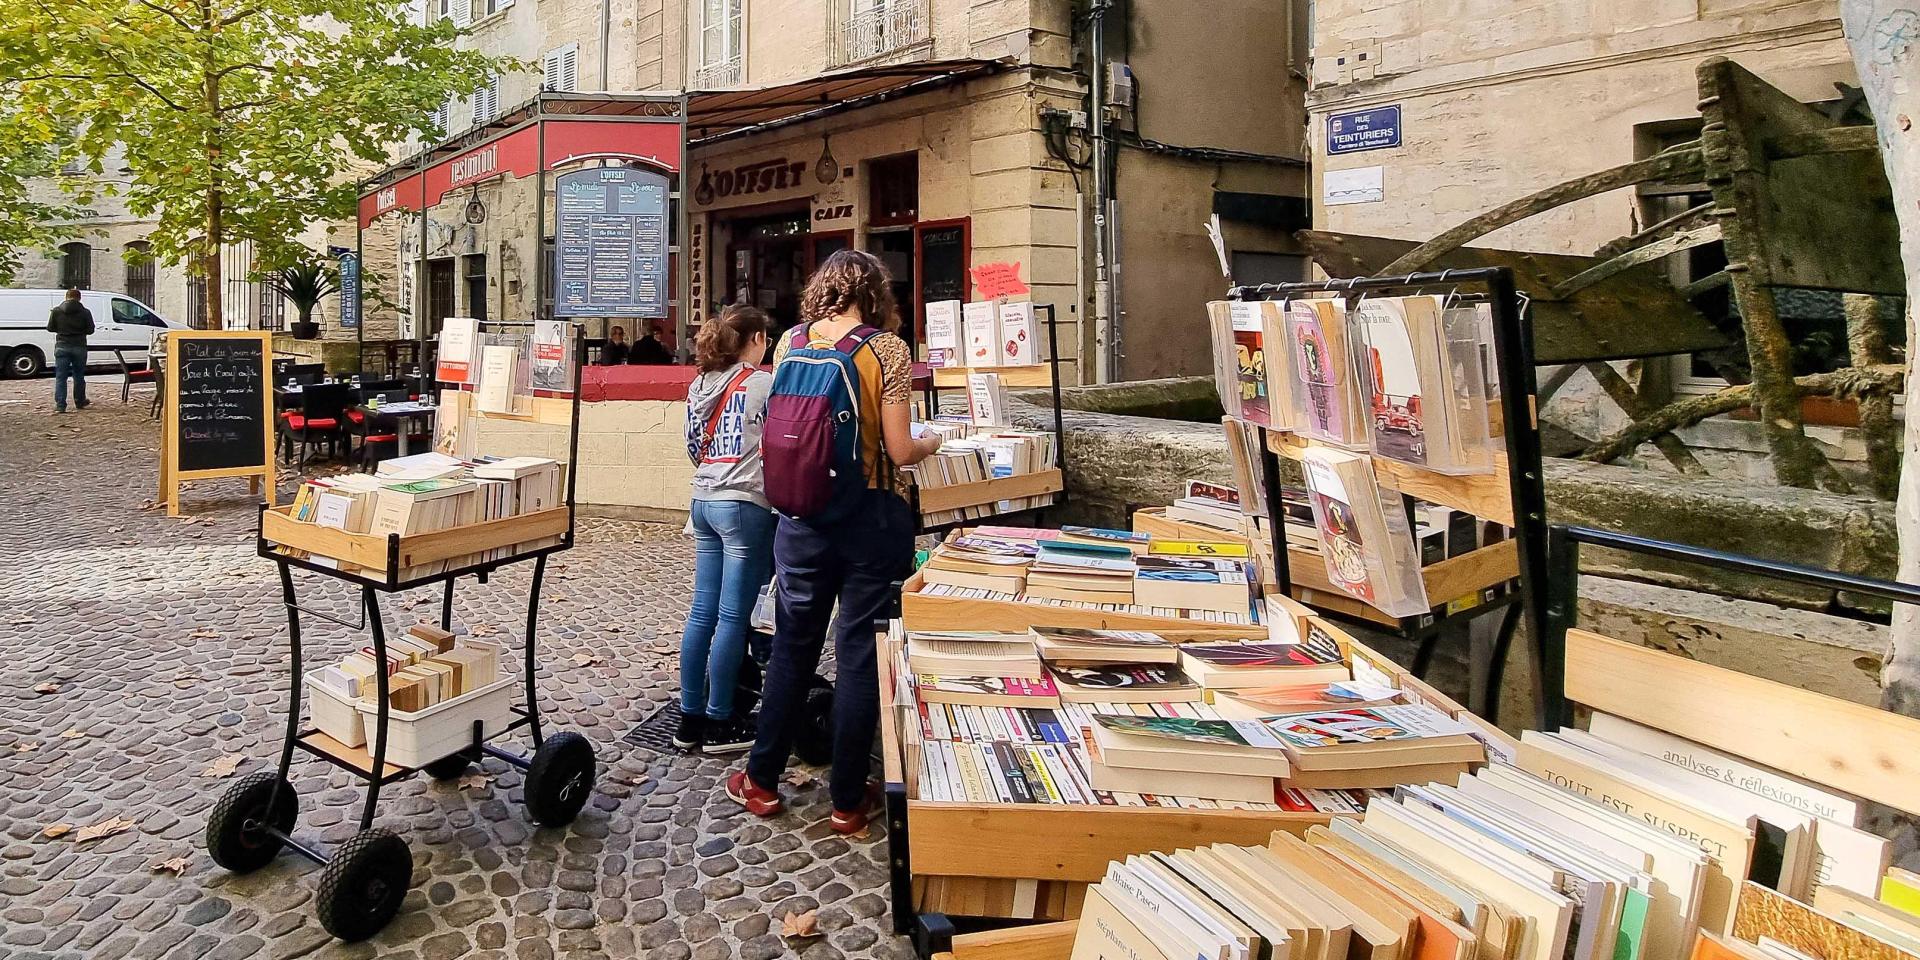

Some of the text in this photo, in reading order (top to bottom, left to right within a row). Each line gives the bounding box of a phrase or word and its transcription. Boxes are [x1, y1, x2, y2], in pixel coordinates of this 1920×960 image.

[1354, 115, 1370, 123] RUE
[1333, 128, 1394, 144] TEINTURIERS
[600, 171, 625, 179] L'OFFSET
[703, 158, 806, 197] 'OFFSET
[815, 205, 854, 221] CAFE
[183, 342, 210, 357] Plat
[733, 415, 742, 433] A
[1663, 748, 1838, 820] analyses & réflexions sur
[1544, 769, 1728, 858] TOUT EST SUSPECT
[1112, 869, 1160, 913] Blaise Pascal
[1096, 917, 1127, 954] Stéphane
